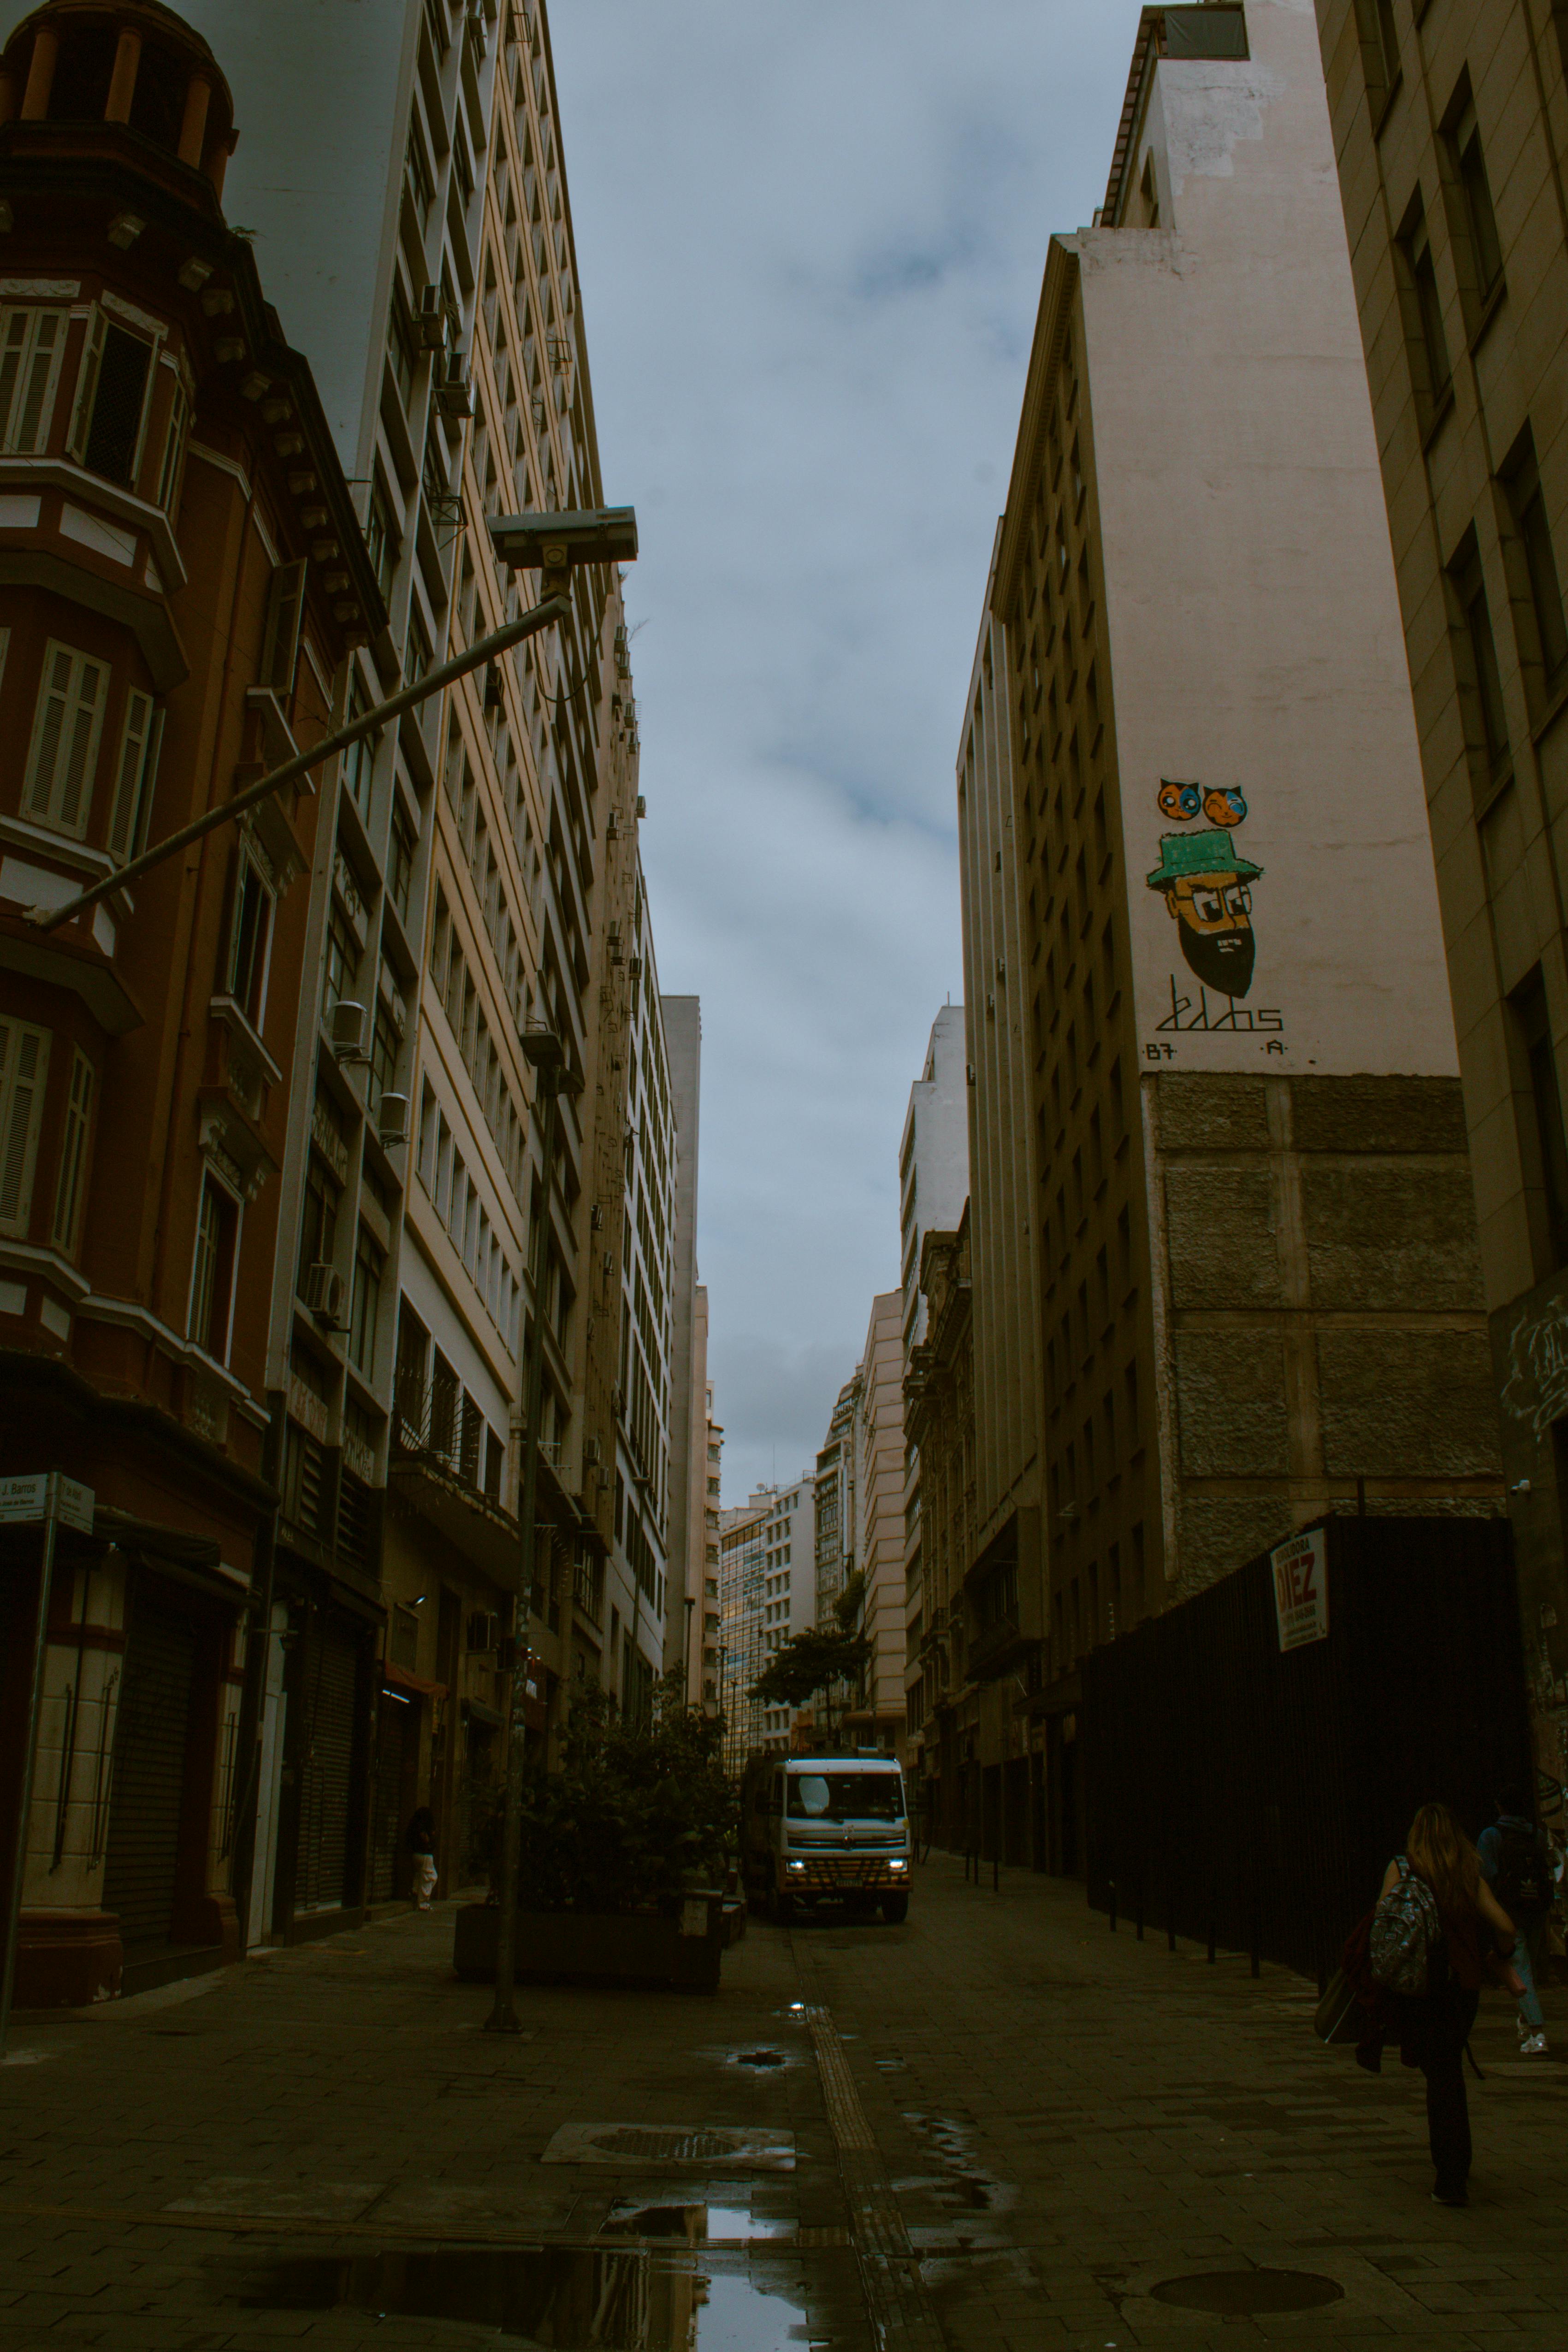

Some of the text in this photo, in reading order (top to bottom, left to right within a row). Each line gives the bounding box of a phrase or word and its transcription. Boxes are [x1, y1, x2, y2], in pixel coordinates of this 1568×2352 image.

[1, 1483, 36, 1495] J. Barros
[1276, 1552, 1317, 1613] DIEZ
